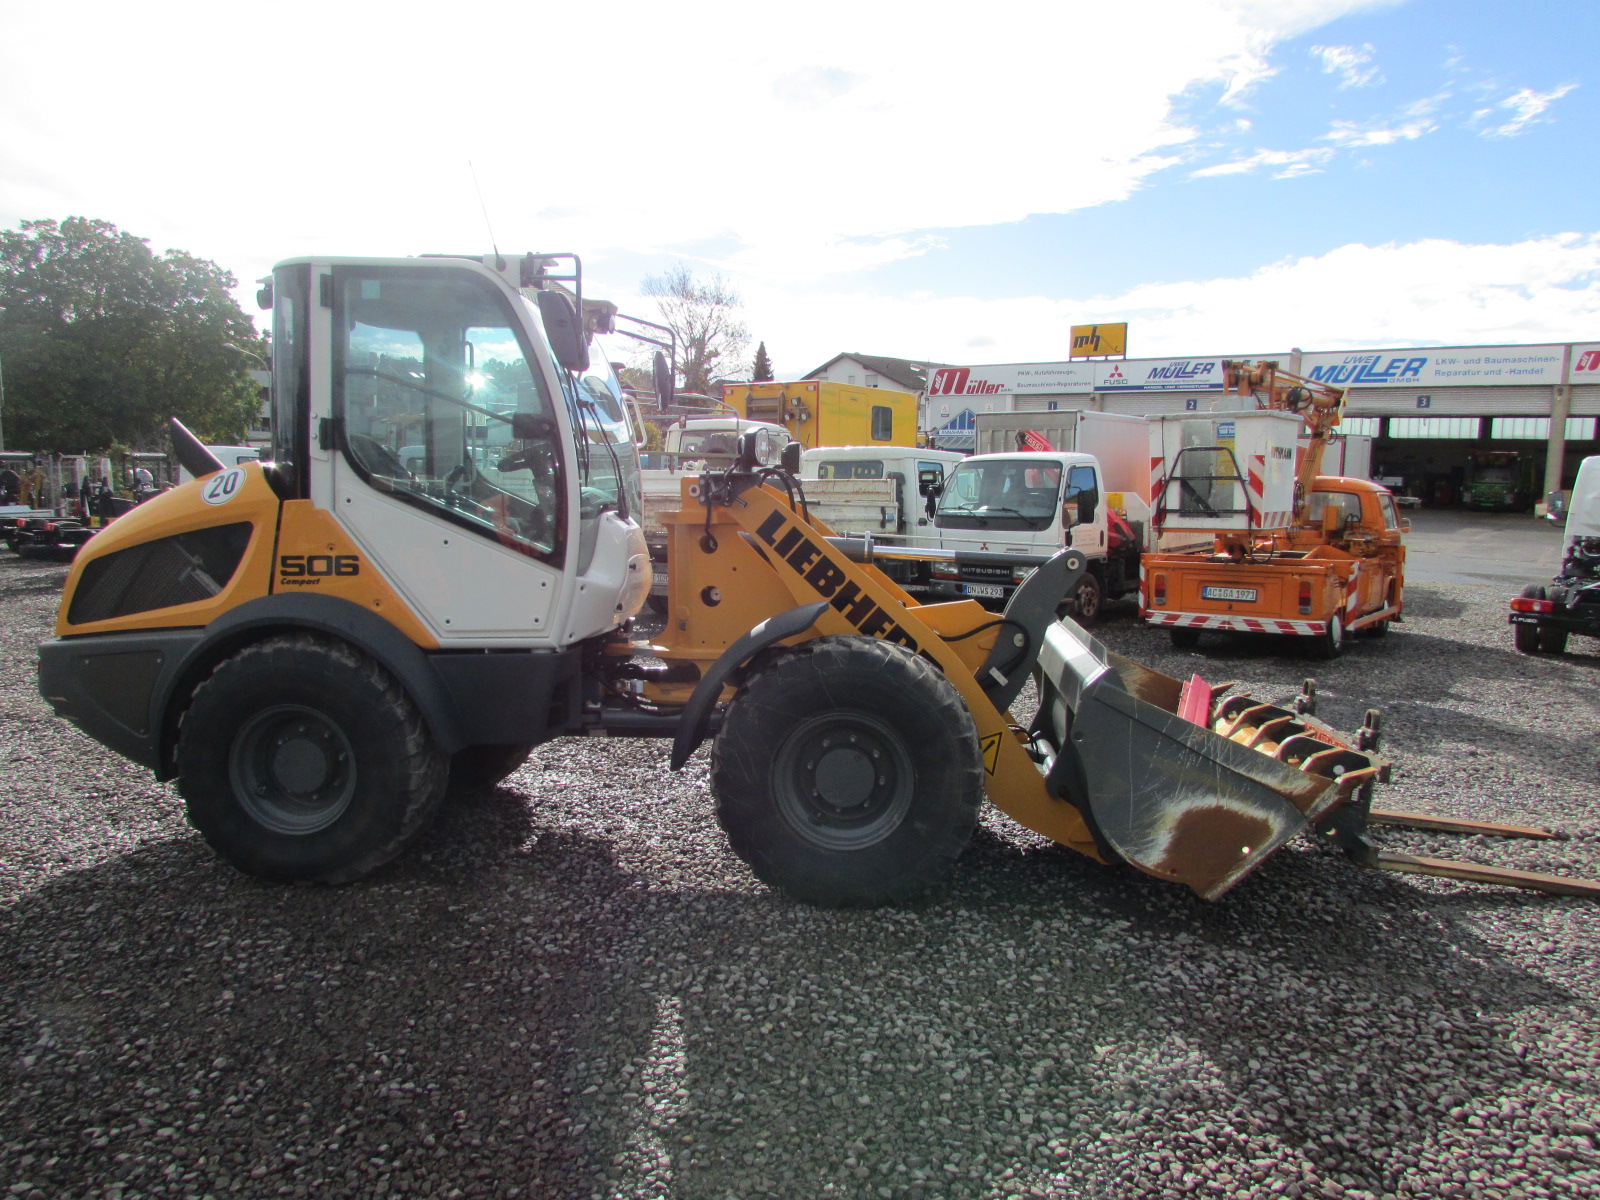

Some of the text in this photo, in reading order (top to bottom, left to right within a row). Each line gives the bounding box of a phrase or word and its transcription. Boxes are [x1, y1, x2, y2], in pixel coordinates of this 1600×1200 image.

[1343, 355, 1375, 364] UWE
[1463, 357, 1481, 365] und
[1484, 355, 1560, 365] Baumaschinen-
[1147, 361, 1216, 380] MÜLLER
[1304, 355, 1428, 384] MÜLLER
[1434, 367, 1544, 378] Reparatur und -Handel
[929, 368, 1004, 395] Müller
[1025, 435, 1044, 452] FASSI
[208, 471, 239, 499] 20
[280, 555, 359, 576] 506
[962, 567, 1010, 575] MITSUBISHI
[280, 578, 320, 586] Compact
[967, 586, 1003, 596] DN WS 293
[1207, 588, 1255, 600] AC GA 1971
